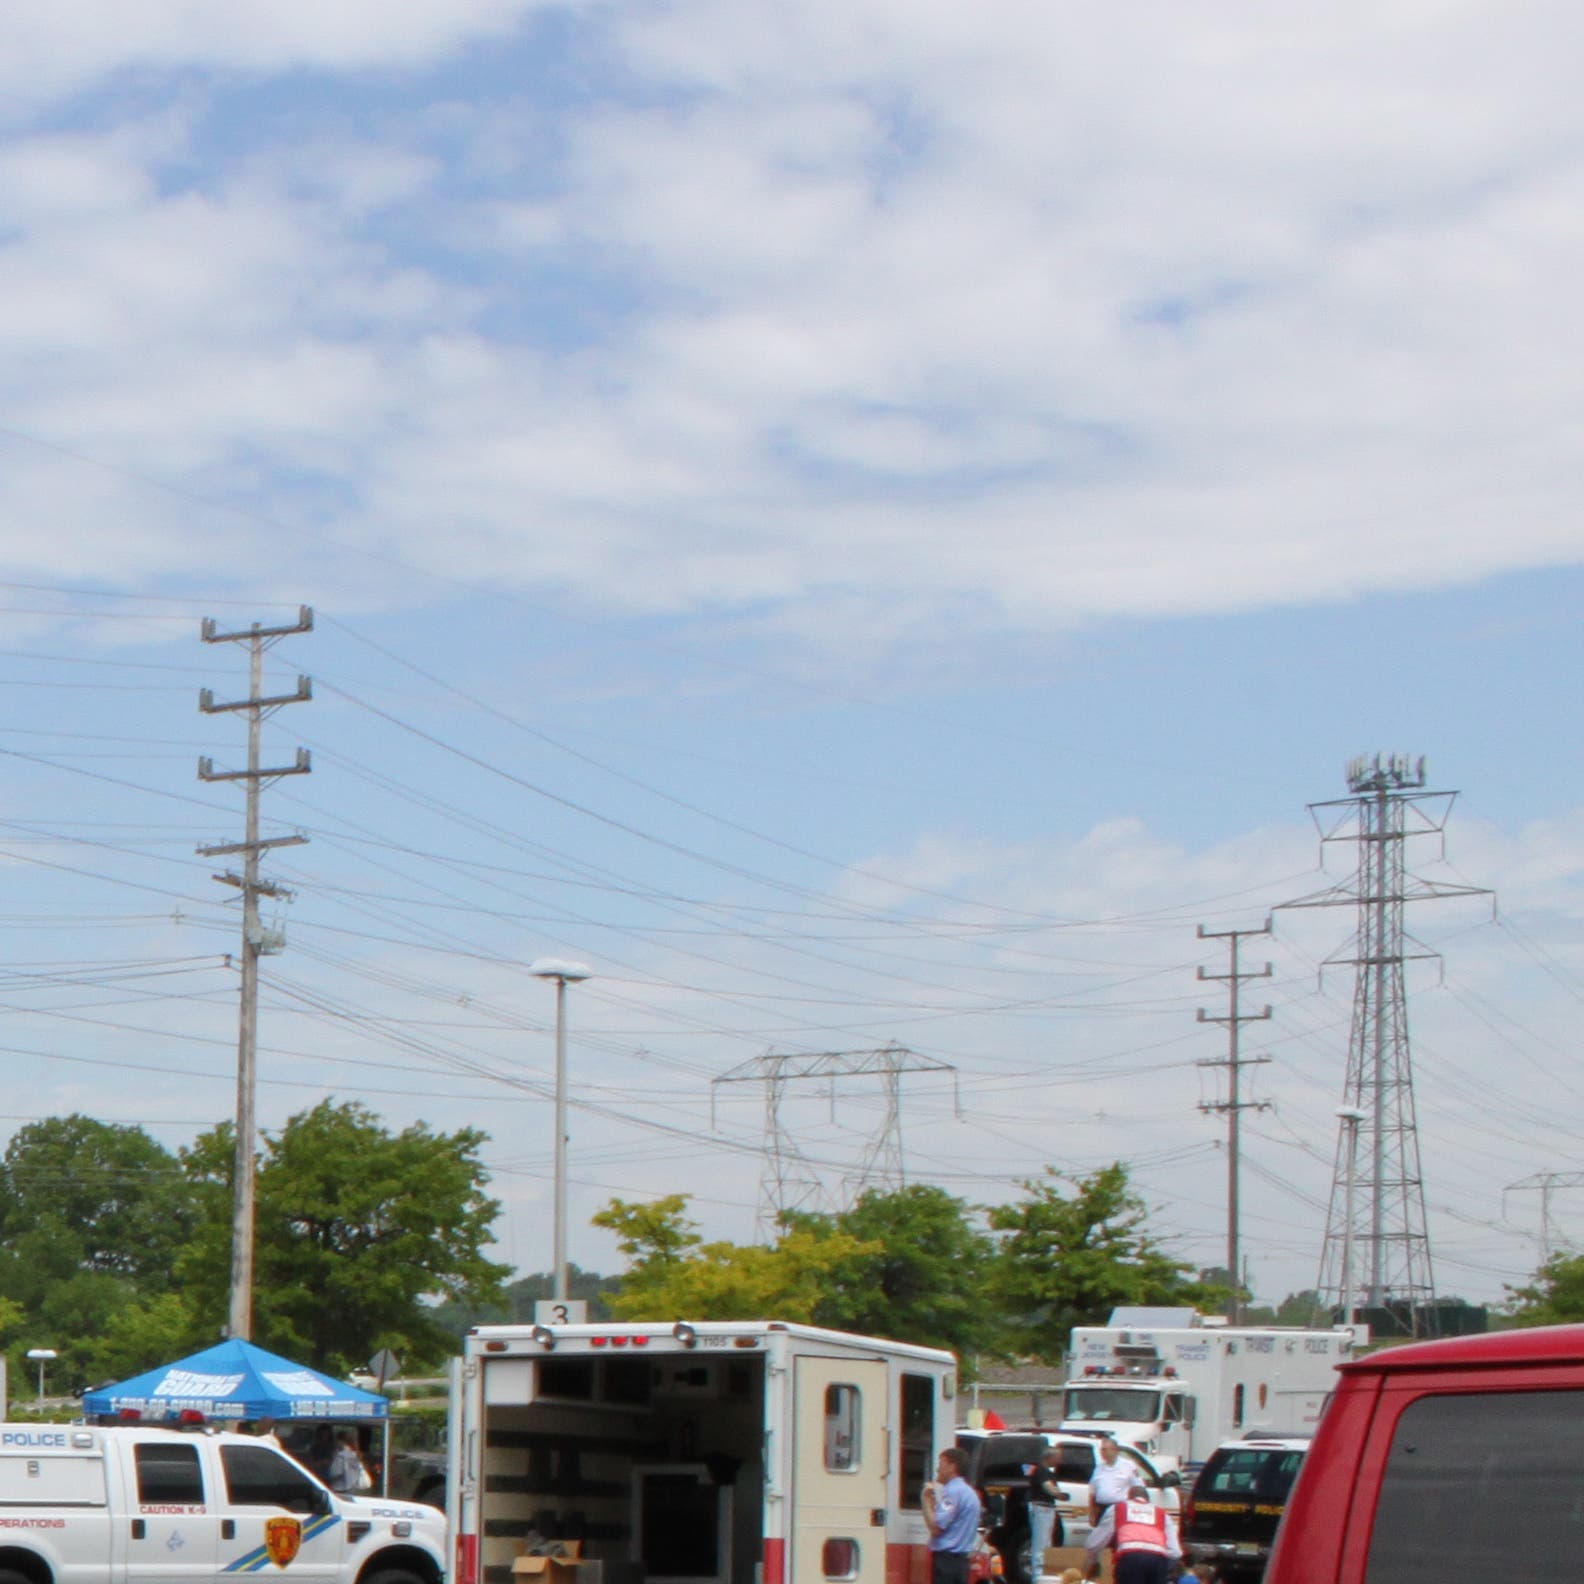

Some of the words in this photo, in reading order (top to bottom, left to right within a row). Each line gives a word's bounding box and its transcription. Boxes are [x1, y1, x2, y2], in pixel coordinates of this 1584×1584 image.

[2, 1433, 65, 1446] POLICE
[140, 1506, 183, 1514] CAUTION
[372, 1509, 424, 1518] POLICE
